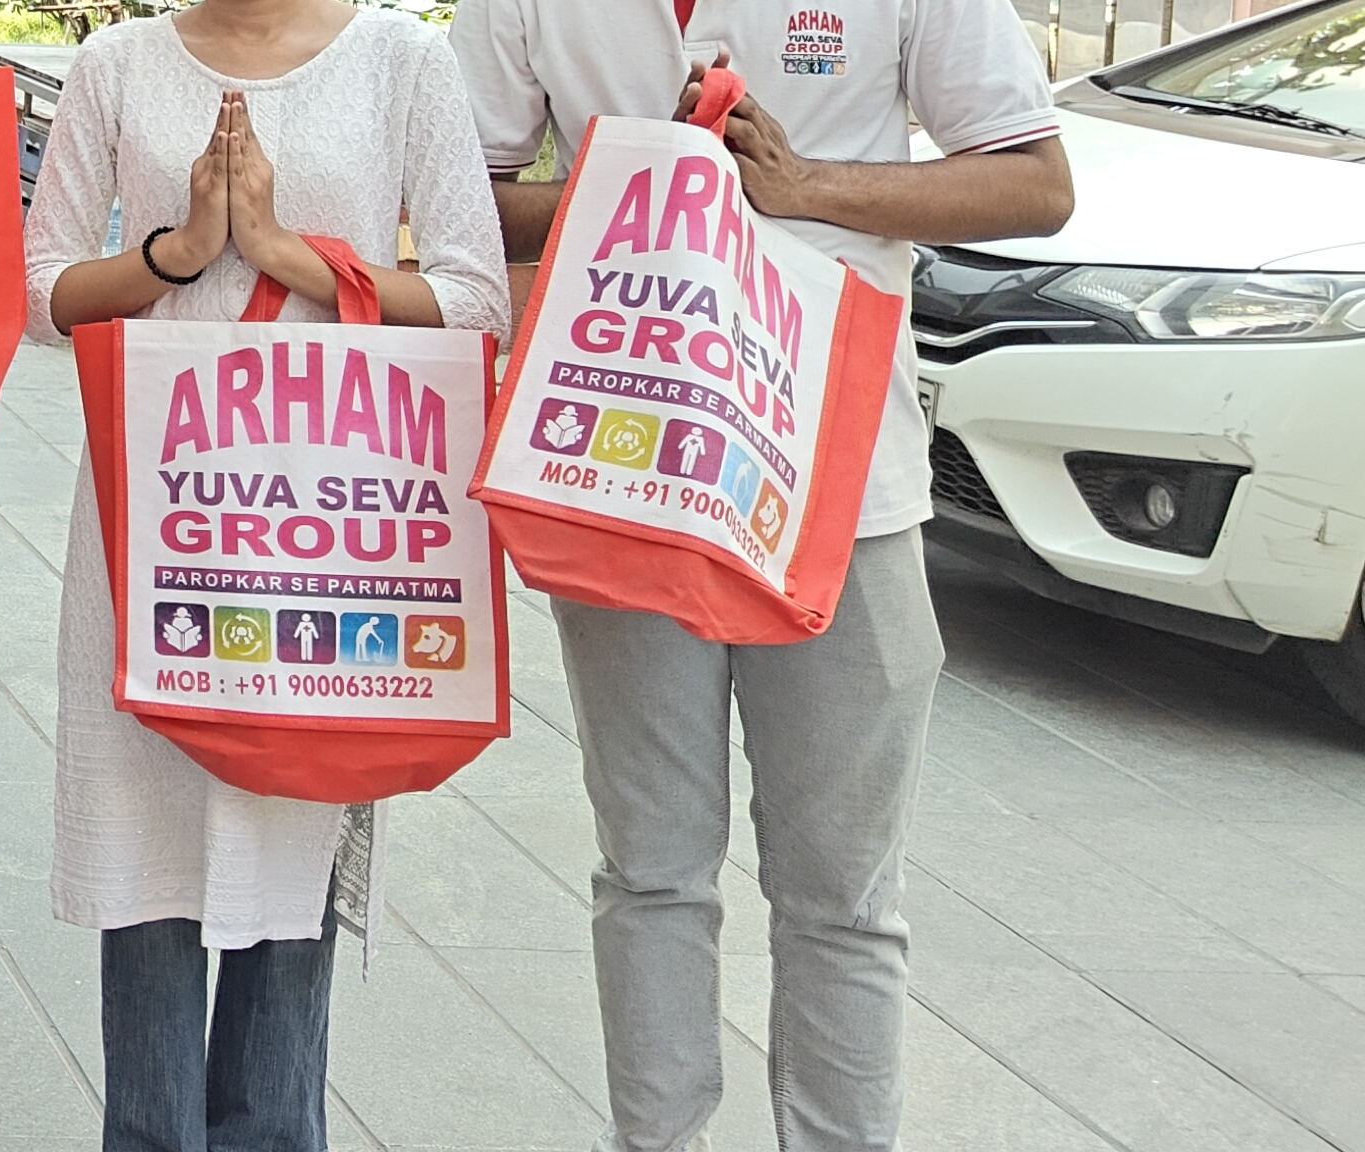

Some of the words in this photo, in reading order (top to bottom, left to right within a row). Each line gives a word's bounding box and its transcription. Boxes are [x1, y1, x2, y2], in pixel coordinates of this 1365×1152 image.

[785, 43, 843, 54] GROUP
[787, 10, 843, 36] ARHAM
[788, 35, 815, 43] YUVA
[817, 36, 843, 45] SEVA
[591, 154, 803, 376] ARHAM
[586, 267, 721, 327] YUVA
[731, 311, 796, 412] SEVA
[570, 308, 796, 439] GROUP
[159, 341, 448, 476] ARHAM
[557, 366, 681, 400] PAROPKAR
[689, 387, 719, 412] SE
[725, 403, 794, 486] PARMATMA
[157, 470, 299, 510] YUVA
[317, 476, 449, 515] SEVA
[539, 459, 598, 491] MOB
[623, 479, 670, 506] +91
[680, 486, 767, 576] 9000633222
[159, 510, 452, 564] GROUP
[161, 570, 283, 592] PAROPKAR
[290, 576, 319, 593] SE
[327, 578, 455, 599] PARMATMA
[156, 670, 212, 693] MOB
[235, 673, 278, 696] +91
[288, 674, 435, 699] 9000633222
